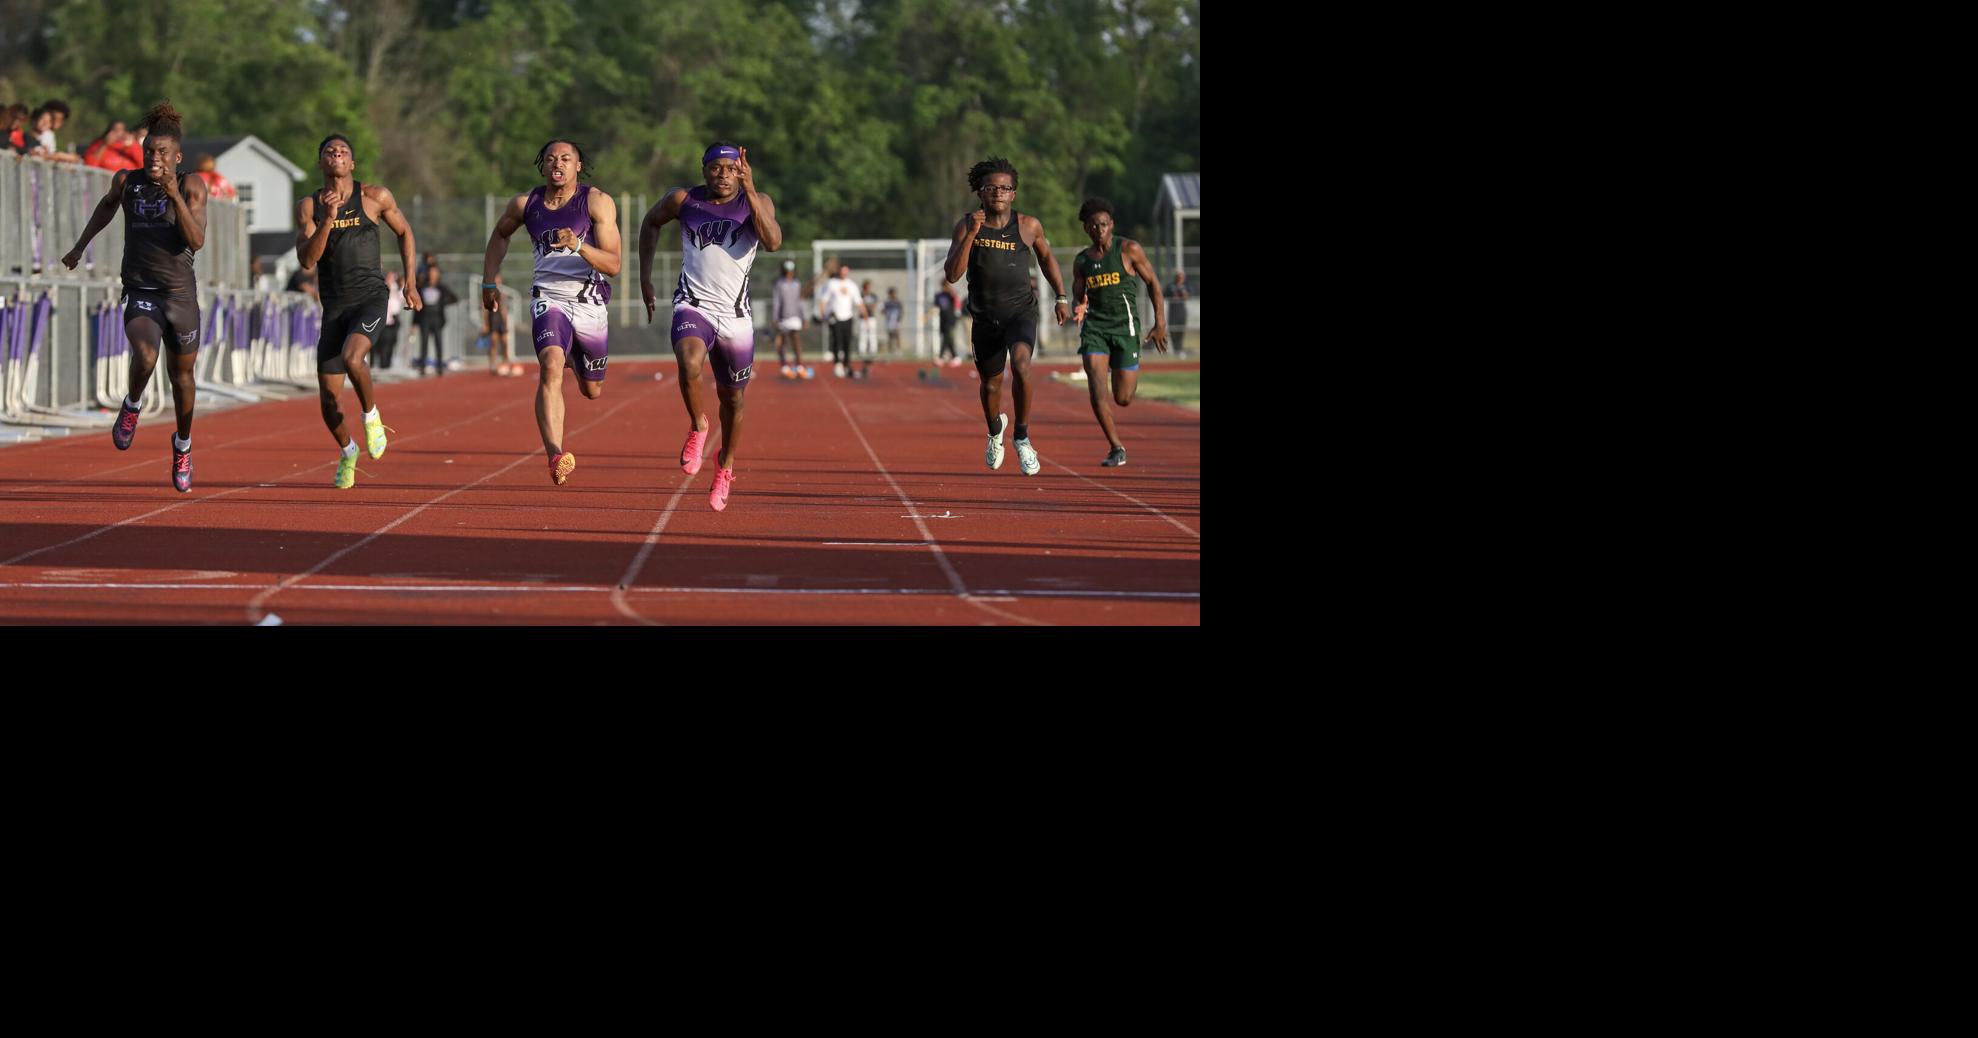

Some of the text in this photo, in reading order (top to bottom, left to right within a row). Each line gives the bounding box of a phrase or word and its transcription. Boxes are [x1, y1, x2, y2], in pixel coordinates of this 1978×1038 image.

[330, 217, 360, 228] STGATE
[698, 219, 733, 251] W
[535, 301, 547, 316] 5
